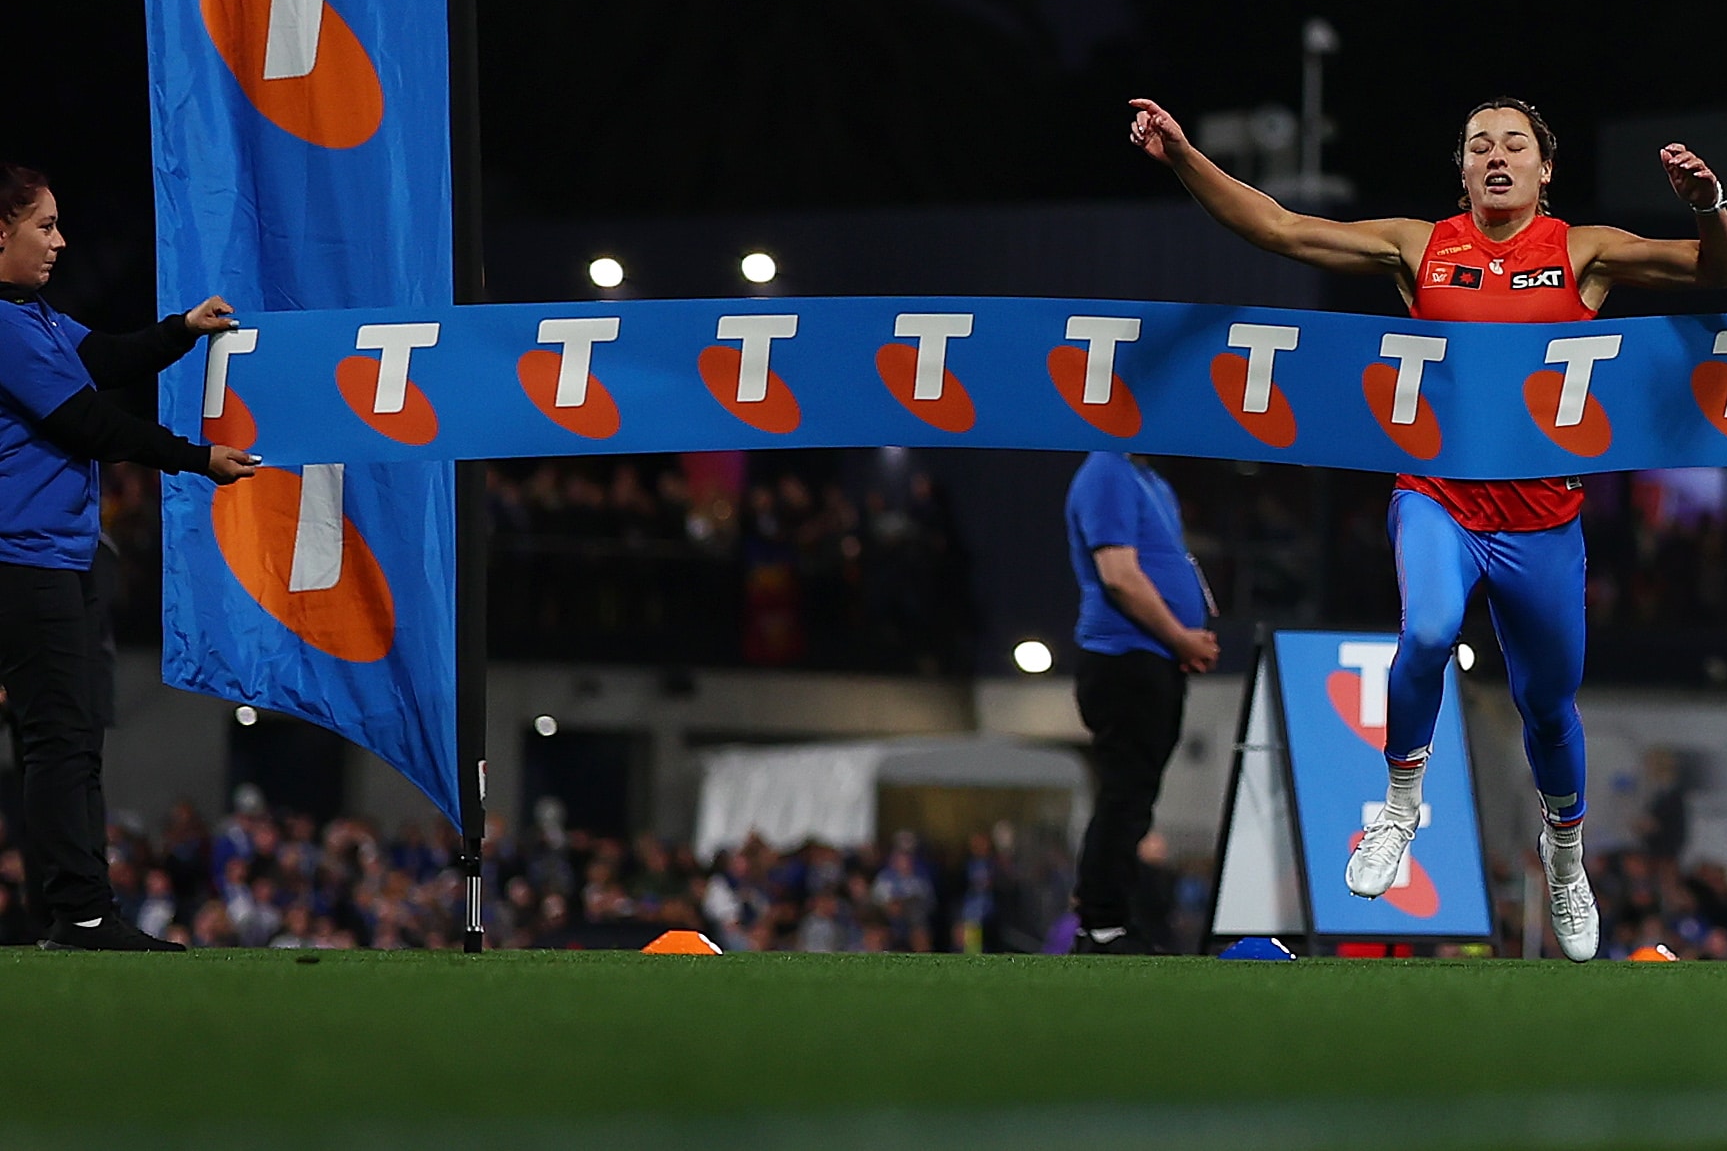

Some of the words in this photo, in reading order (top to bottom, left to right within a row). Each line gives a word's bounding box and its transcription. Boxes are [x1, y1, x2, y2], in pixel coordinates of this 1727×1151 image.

[357, 323, 439, 413] T
[538, 318, 620, 406] T
[717, 315, 798, 401] T
[895, 314, 973, 399] T
[1066, 316, 1141, 404] T
[1228, 324, 1299, 412] T
[1380, 334, 1447, 424] T
[1545, 335, 1622, 426] T
